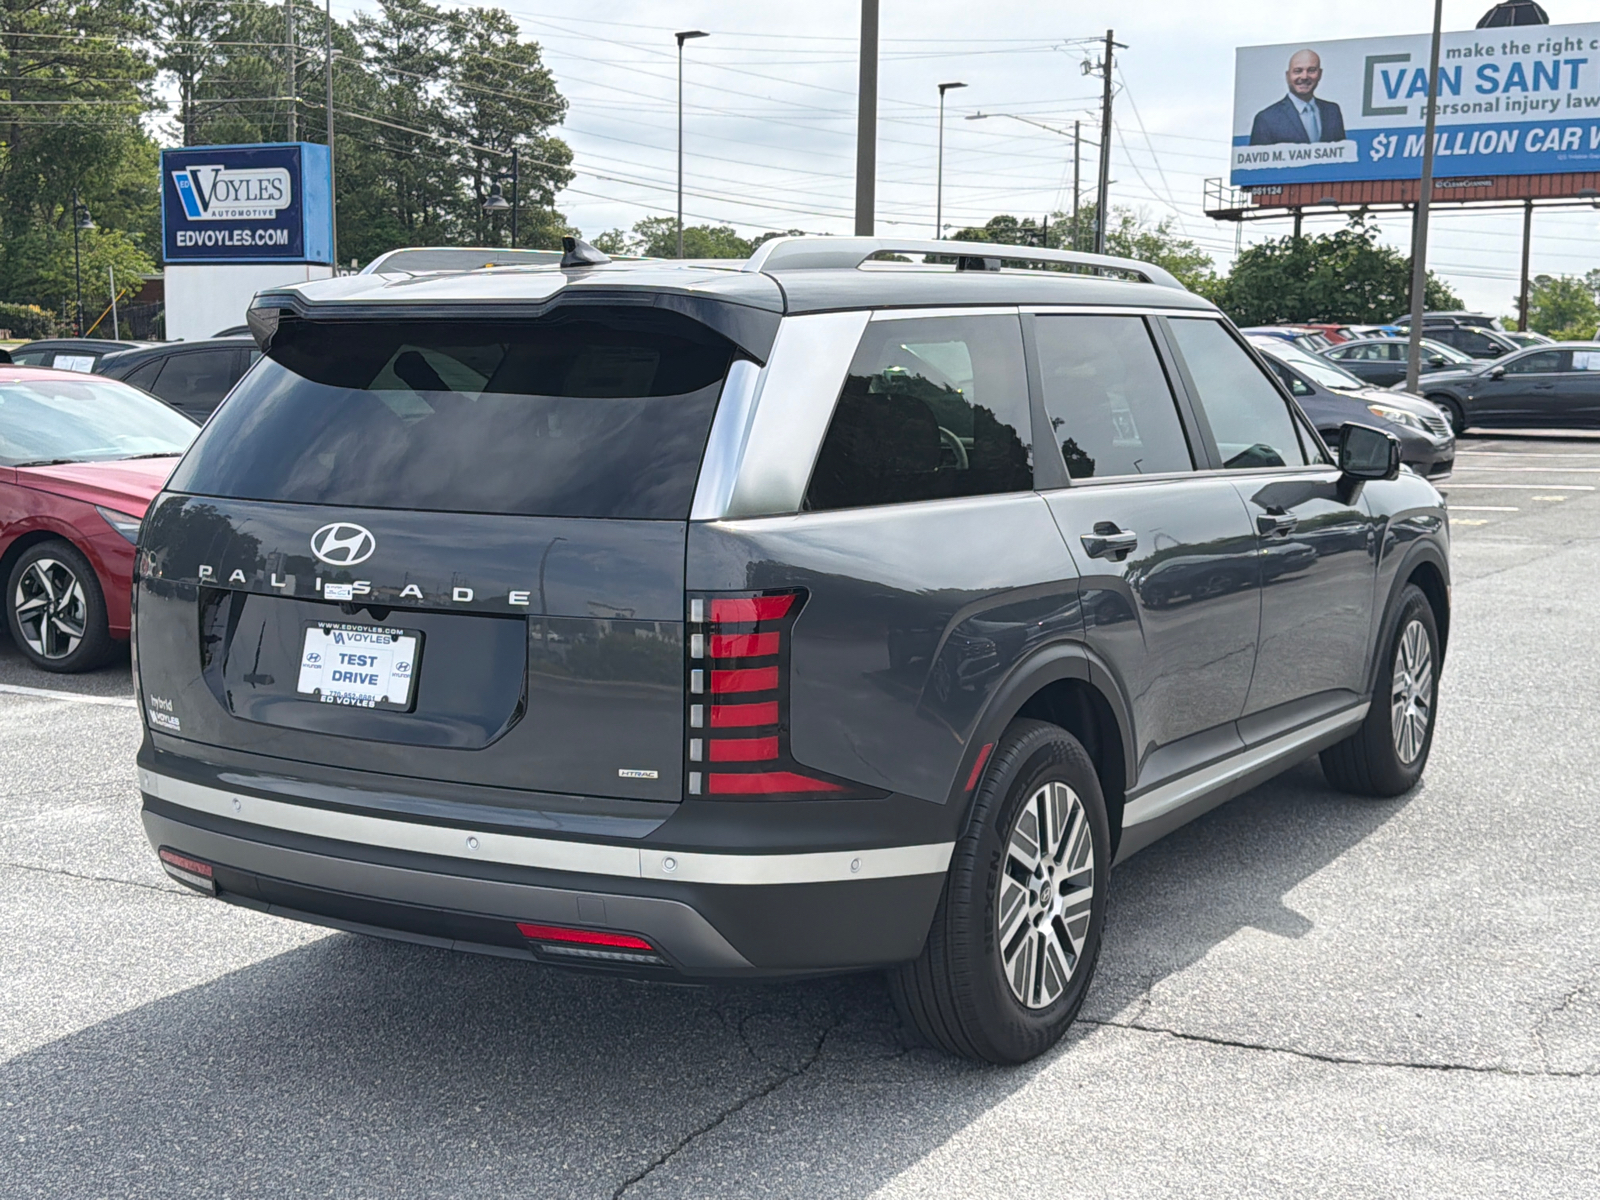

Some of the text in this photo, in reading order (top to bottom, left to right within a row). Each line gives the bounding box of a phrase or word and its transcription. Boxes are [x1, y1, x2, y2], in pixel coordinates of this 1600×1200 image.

[1446, 43, 1495, 59] make
[1501, 40, 1531, 55] the
[1537, 37, 1583, 56] right
[1381, 58, 1588, 100] VAN SANT
[1420, 97, 1499, 120] personal
[1505, 95, 1560, 115] injury
[1369, 132, 1399, 162] $1
[1402, 129, 1520, 158] MILLION
[1524, 126, 1583, 153] CAR
[1237, 146, 1345, 164] DAVID M. VAN SANT
[180, 181, 190, 189] ED
[189, 168, 283, 213] VOYLES
[211, 209, 274, 218] AUTOMOTIVE
[176, 229, 289, 247] EDVOYLES.COM
[197, 564, 532, 606] PALISADE
[317, 621, 404, 636] WWW.EDVOYLES.COM
[339, 653, 378, 668] TEST
[331, 670, 379, 686] DRIVE
[320, 695, 376, 708] ED VOYLES
